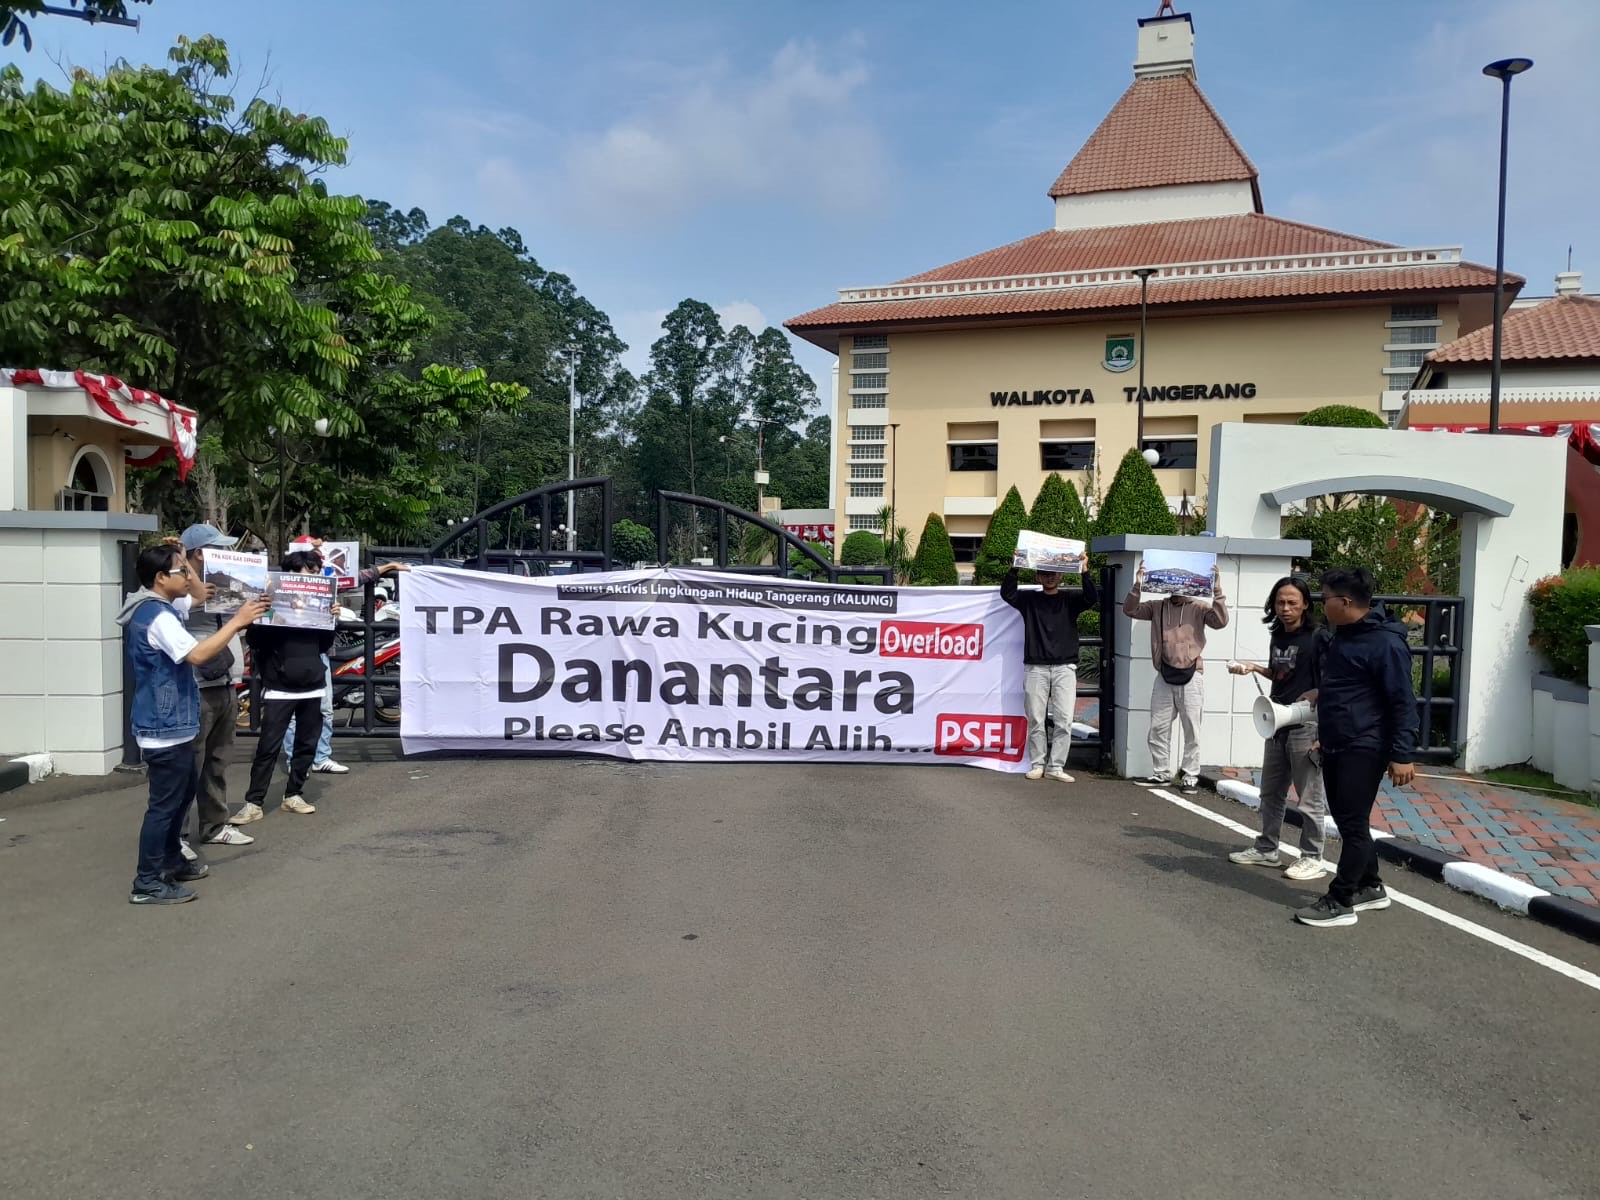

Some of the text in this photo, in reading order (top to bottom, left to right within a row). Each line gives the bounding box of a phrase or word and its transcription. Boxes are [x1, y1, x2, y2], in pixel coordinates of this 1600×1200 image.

[990, 382, 1257, 407] WALIKOTA TANGERANG
[303, 576, 331, 585] TUNTAS
[605, 583, 648, 595] Aktivis
[651, 583, 723, 599] Lingkungan
[726, 588, 763, 602] Hidup
[765, 590, 830, 606] Tangerang
[833, 593, 894, 608] (KALUNG)
[414, 606, 980, 656] TPA Rawa Kucing Overload
[498, 642, 915, 714] Danantara
[503, 716, 645, 745] Please
[657, 719, 791, 751] Ambil
[940, 720, 1019, 755] PSEL
